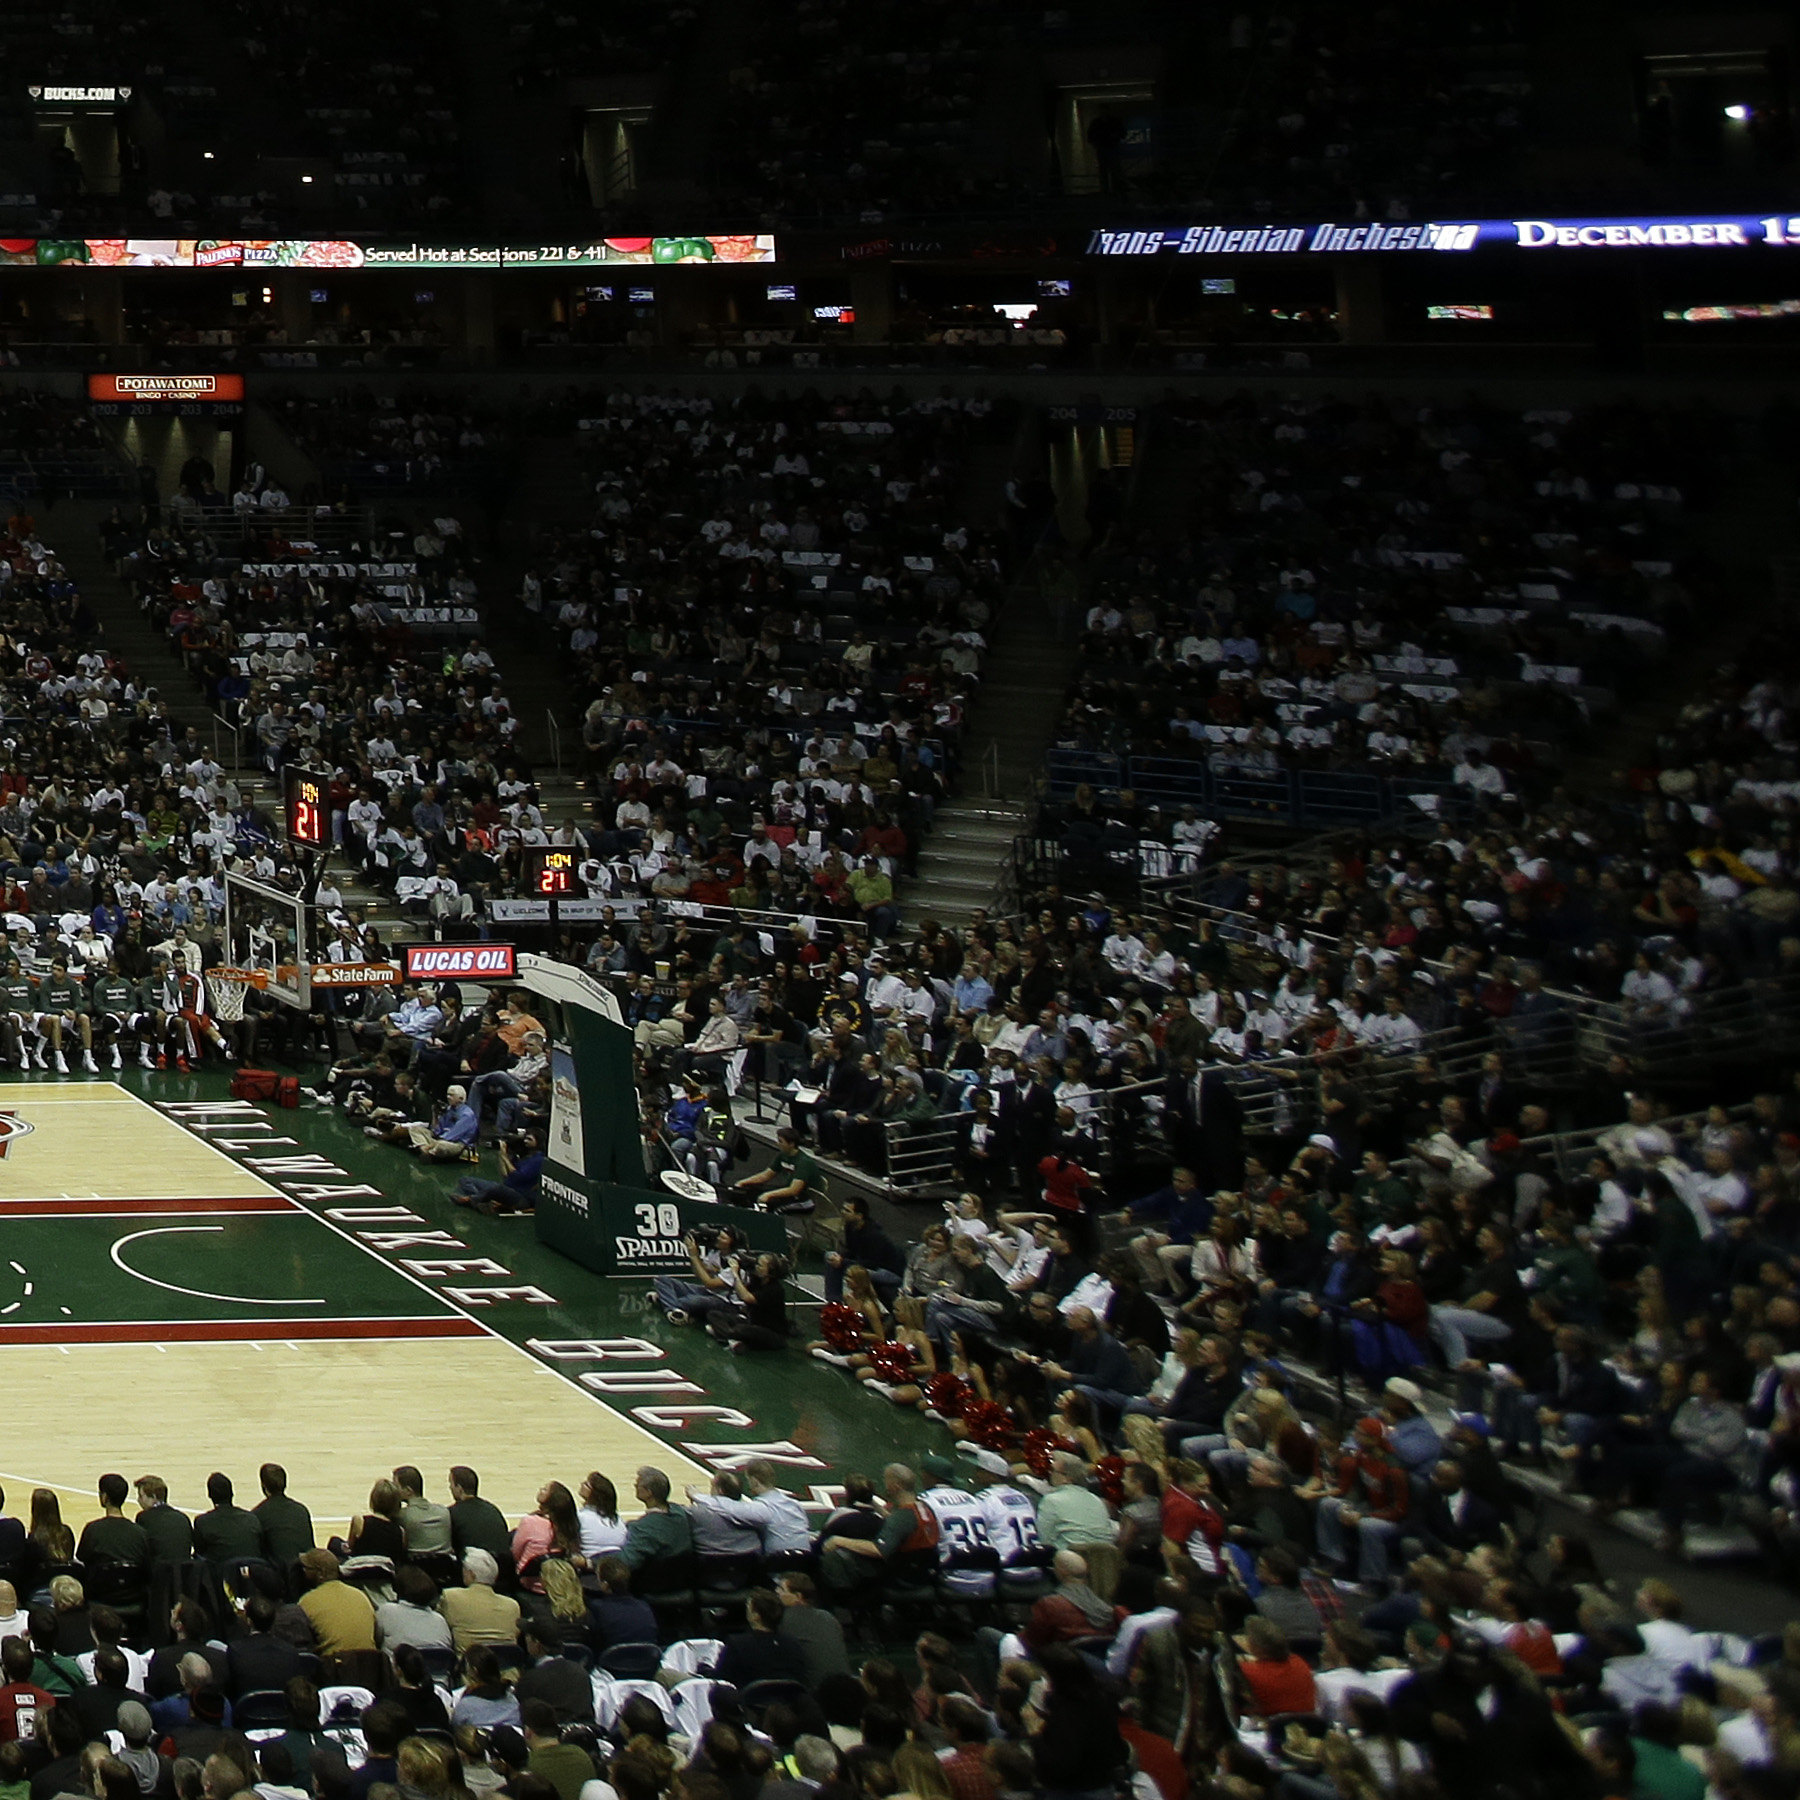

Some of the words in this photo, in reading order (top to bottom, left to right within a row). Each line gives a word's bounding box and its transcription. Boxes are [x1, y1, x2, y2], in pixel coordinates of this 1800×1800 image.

[43, 86, 115, 102] BUCKS.COM
[1511, 218, 1744, 249] DECEMBER
[365, 244, 417, 262] Served
[419, 247, 448, 262] Hot
[450, 249, 466, 262] at
[468, 246, 538, 262] Sections
[539, 247, 564, 261] 221
[566, 247, 582, 260] &
[584, 246, 607, 260] 411
[124, 378, 208, 389] POTAWATOMI
[545, 853, 572, 868] 1:04
[541, 870, 565, 892] 21
[412, 951, 473, 971] LUCAS
[478, 950, 507, 969] OIL
[332, 968, 394, 983] StateFarm
[541, 1174, 589, 1211] FRONTIER
[156, 1099, 561, 1309] MILWAUKEE
